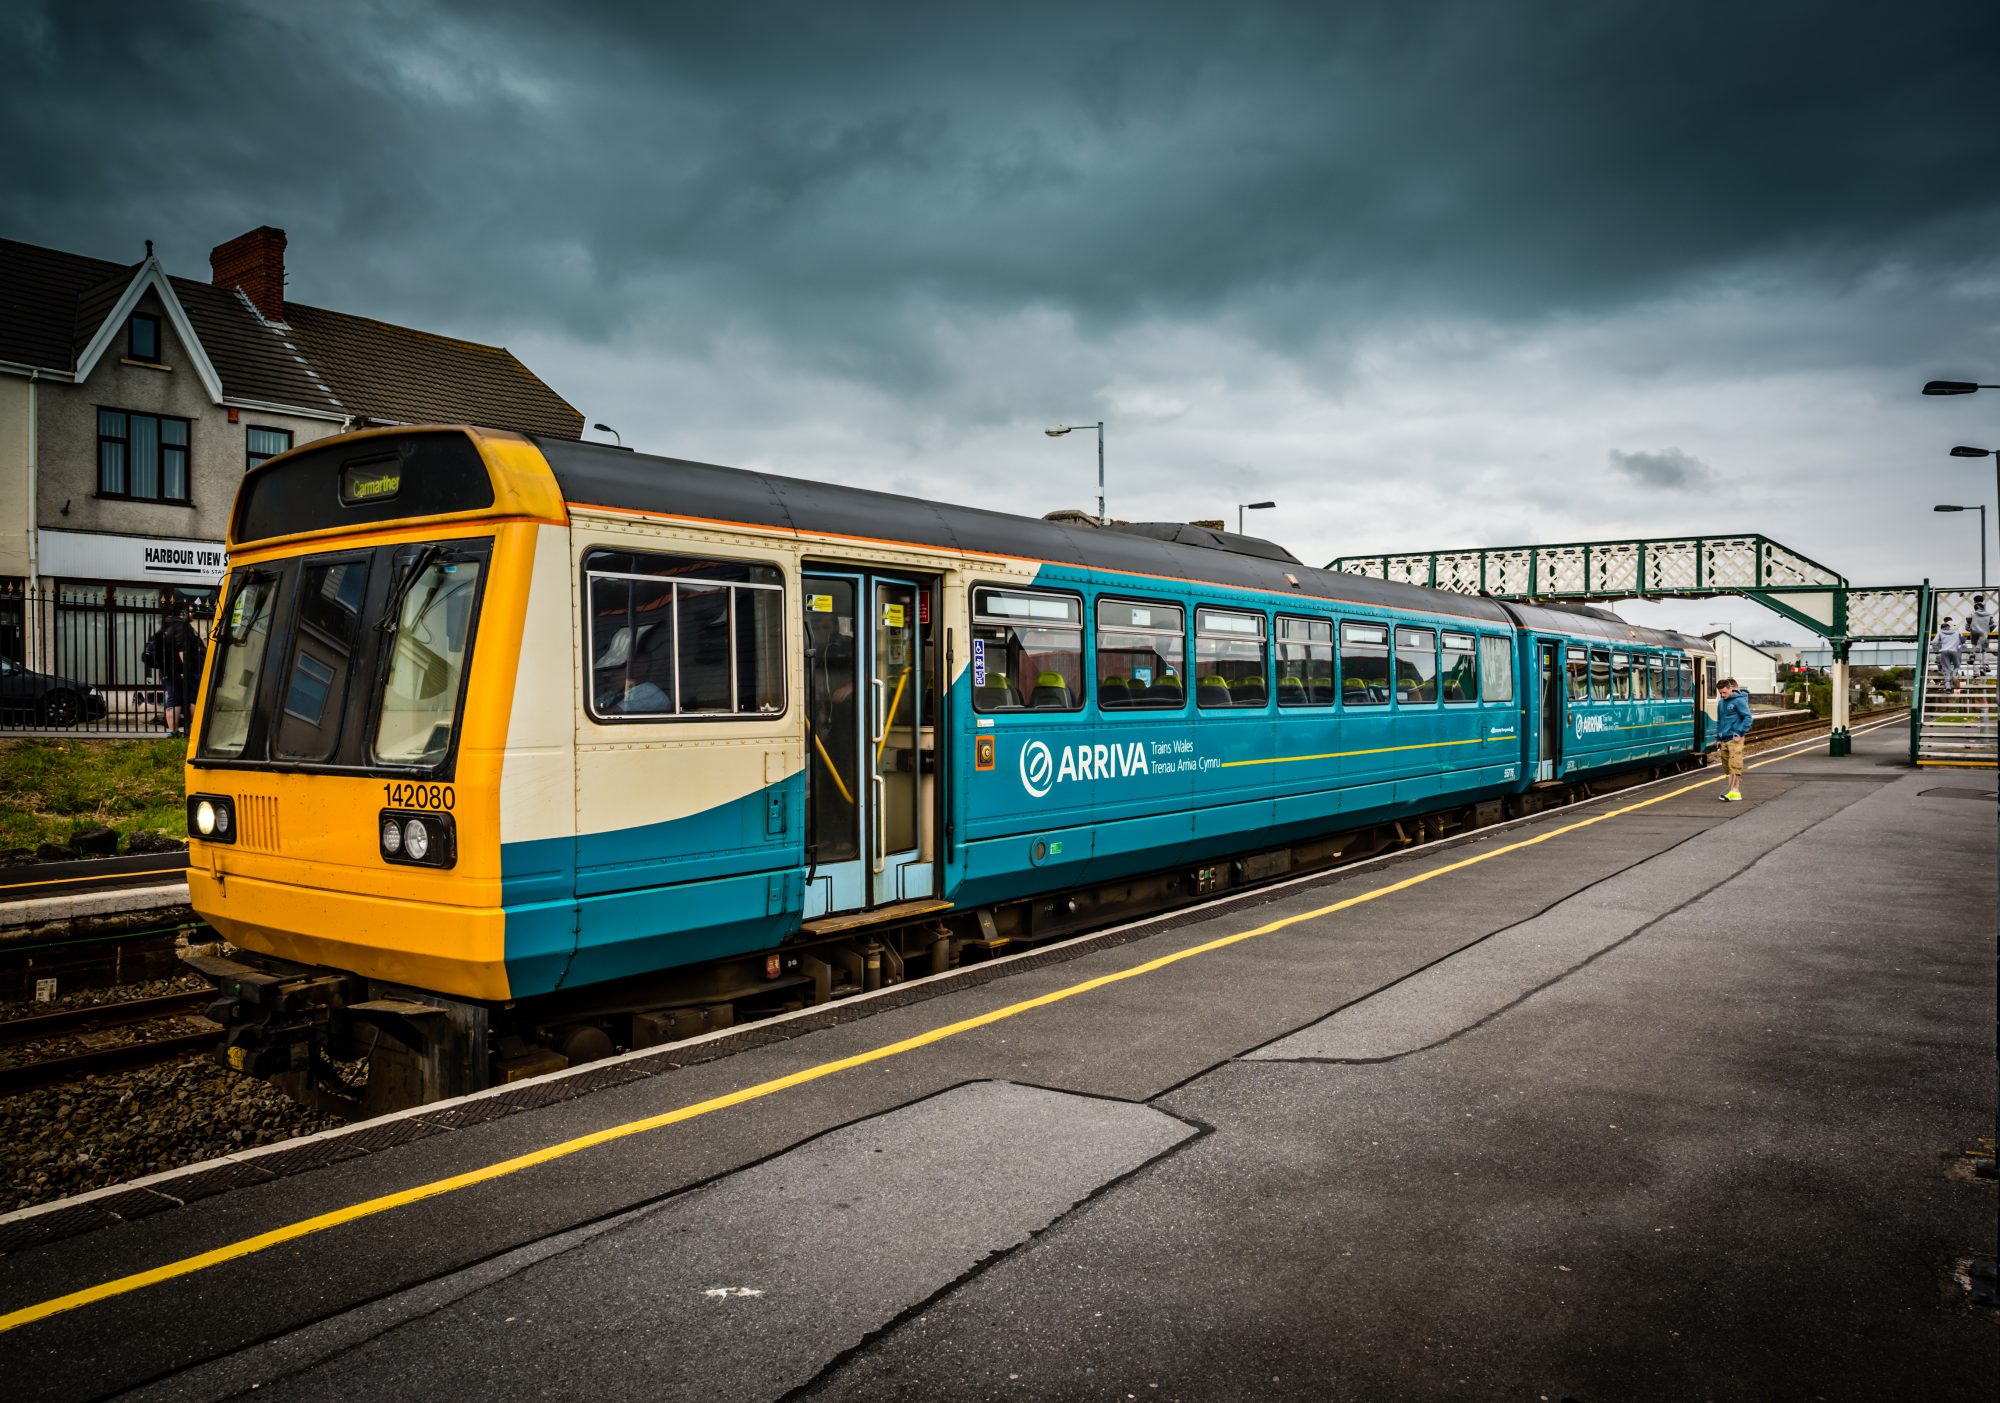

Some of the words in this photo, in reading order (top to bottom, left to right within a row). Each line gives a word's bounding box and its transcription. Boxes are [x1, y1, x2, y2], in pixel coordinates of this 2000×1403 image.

[145, 547, 194, 565] HARBOUR
[197, 551, 221, 566] VIEW
[1151, 740, 1172, 755] Trains
[1173, 739, 1194, 753] Wales
[1056, 741, 1149, 783] ARRIVA
[1151, 760, 1176, 774] Trenau
[1177, 758, 1197, 772] Arriva
[1199, 756, 1221, 773] Cymru
[383, 783, 456, 810] 142080
